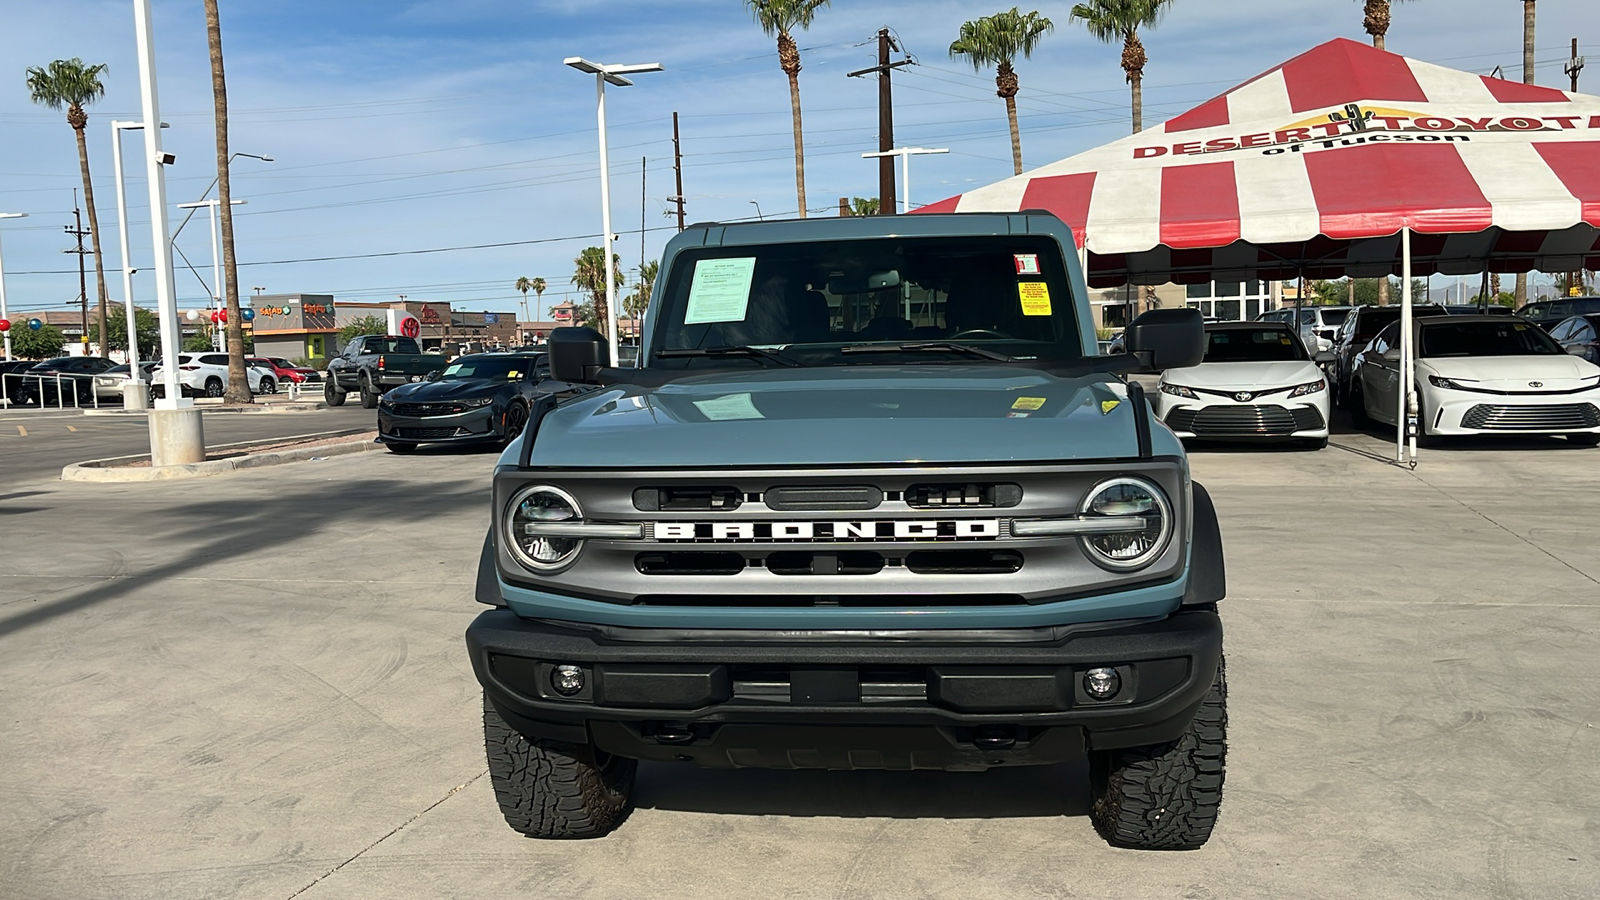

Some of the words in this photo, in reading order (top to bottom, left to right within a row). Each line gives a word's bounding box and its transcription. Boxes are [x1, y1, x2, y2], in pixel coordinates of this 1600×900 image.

[1133, 119, 1349, 159] DESERT
[1374, 115, 1600, 131] TOYOT
[1262, 142, 1304, 155] of
[1312, 134, 1471, 149] Tucson
[653, 520, 999, 541] BRONCO
